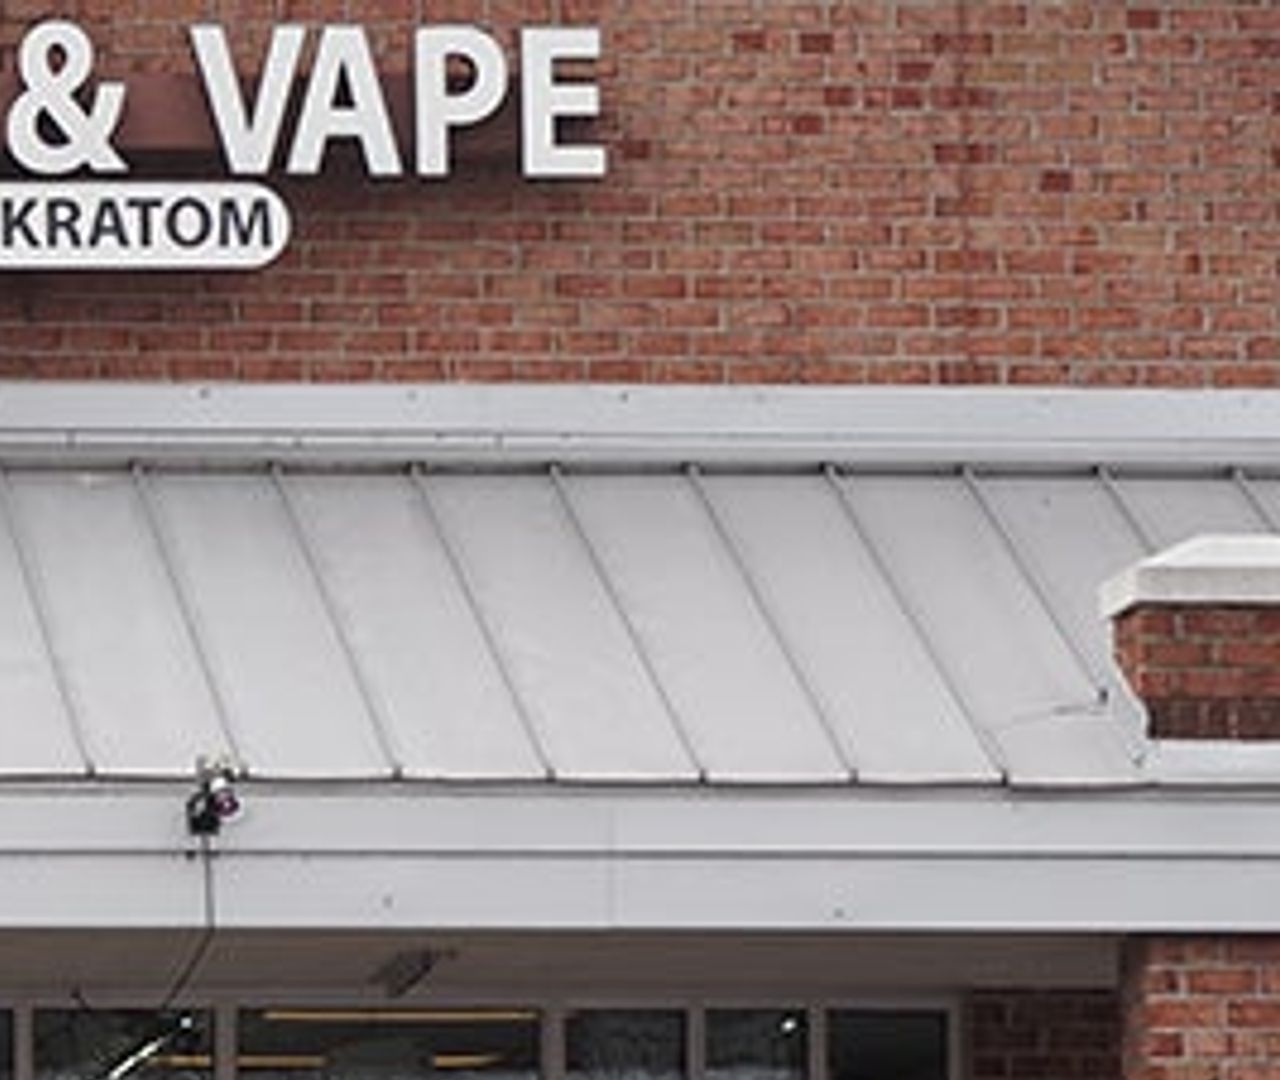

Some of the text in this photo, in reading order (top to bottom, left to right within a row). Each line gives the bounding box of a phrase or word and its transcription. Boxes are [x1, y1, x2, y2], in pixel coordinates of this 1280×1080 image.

[5, 20, 129, 175] &
[189, 22, 608, 178] VAPE
[2, 197, 274, 248] KRATOM
